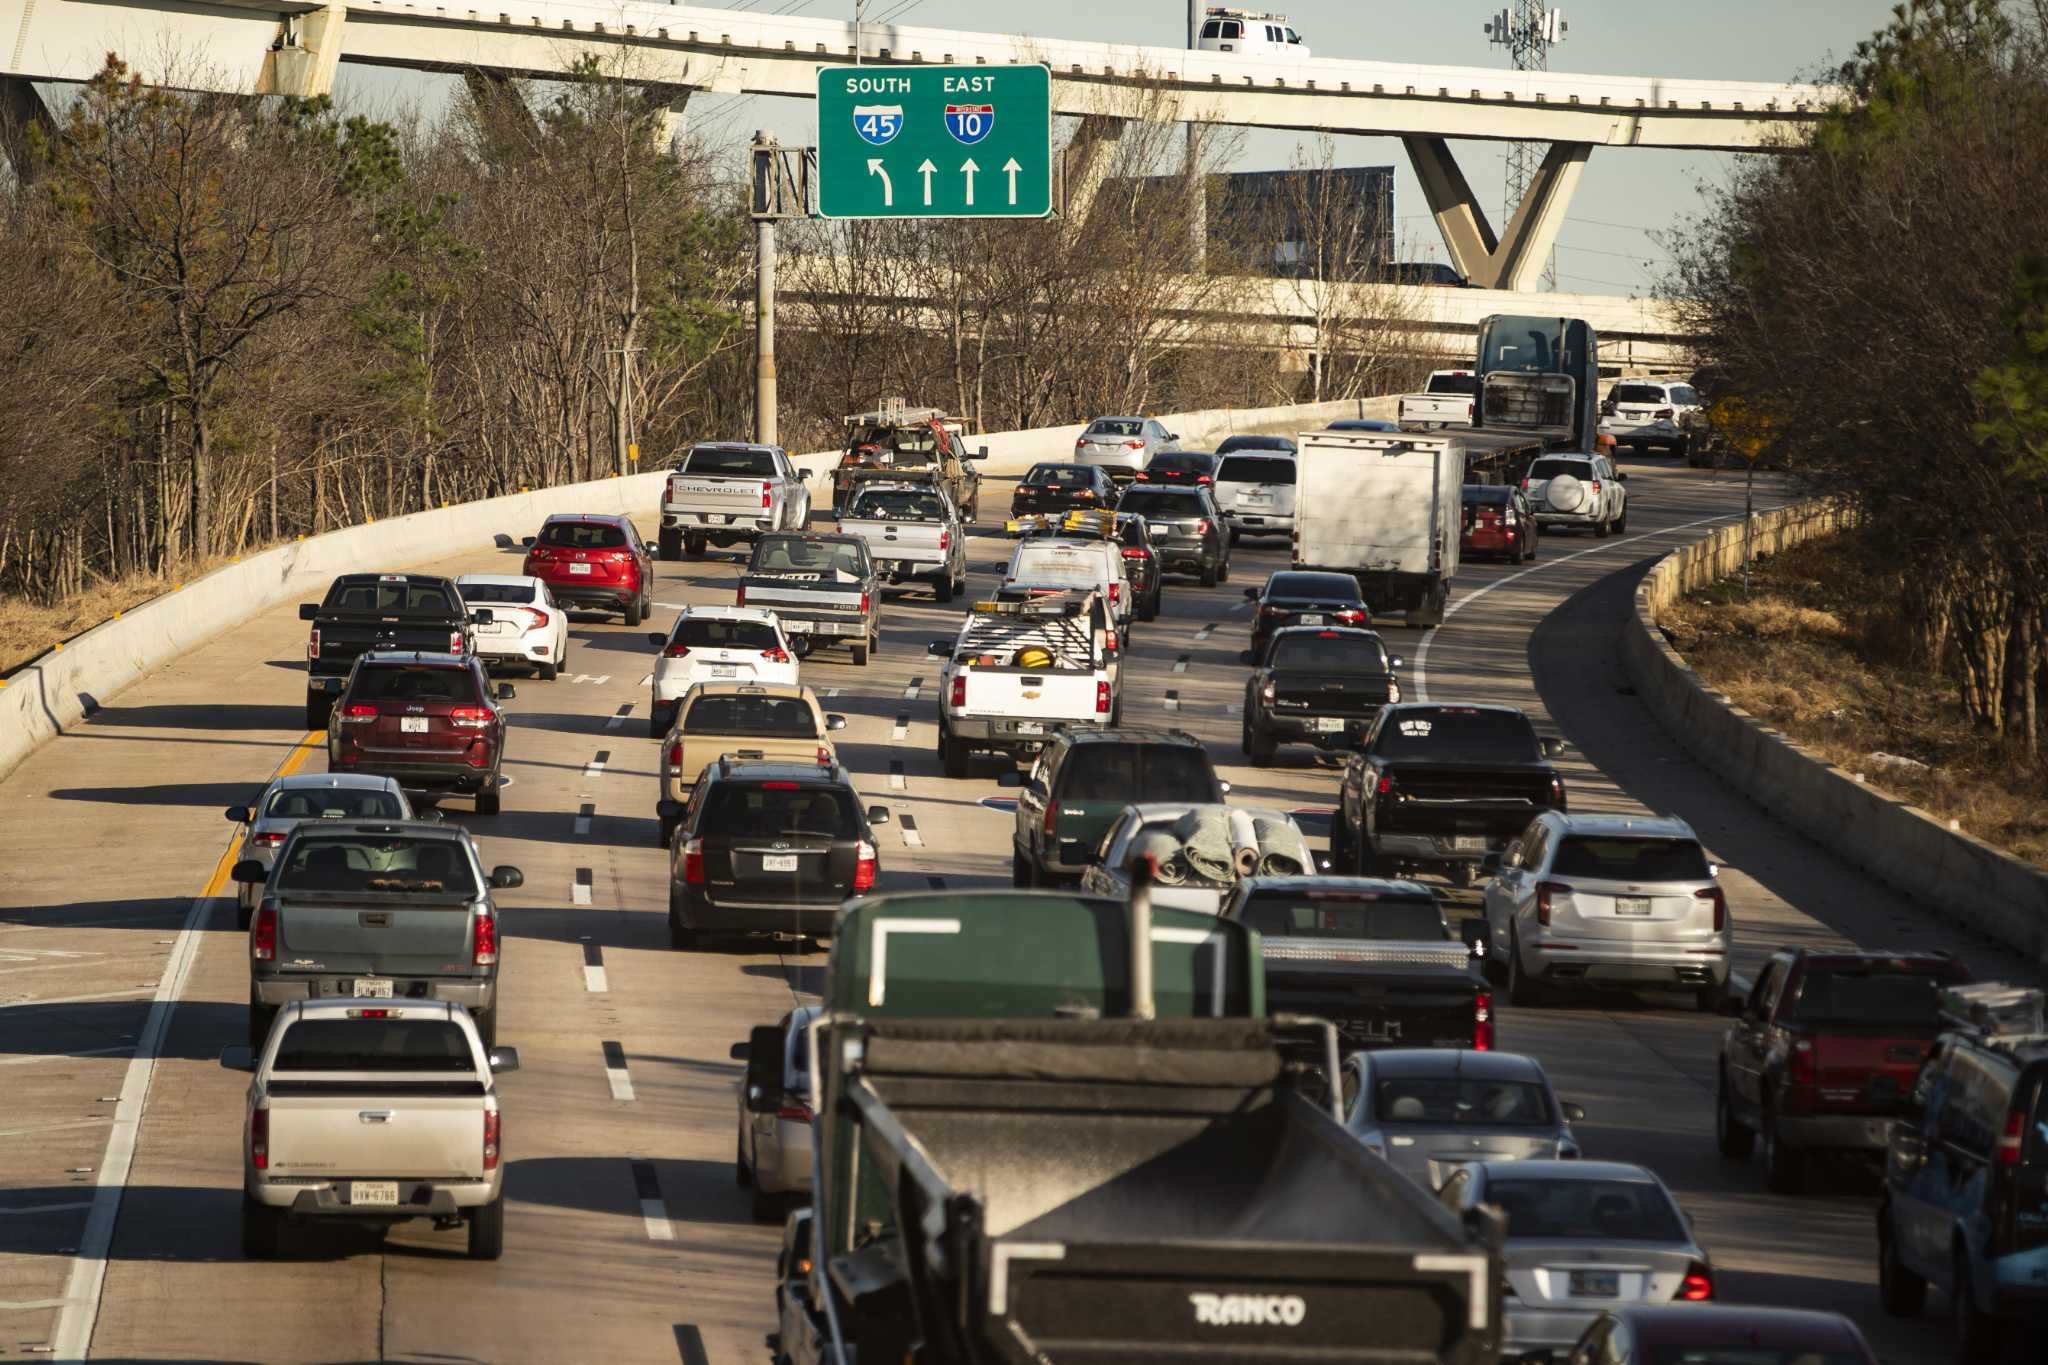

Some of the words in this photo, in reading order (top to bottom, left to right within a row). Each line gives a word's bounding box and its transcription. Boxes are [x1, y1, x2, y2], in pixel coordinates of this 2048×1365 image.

[846, 78, 911, 94] SOUTH
[943, 76, 995, 93] EAST
[862, 115, 895, 138] 45
[957, 113, 982, 137] 10
[679, 485, 755, 494] CHEVROLET
[833, 602, 859, 612] FORD
[406, 704, 425, 713] Jeep
